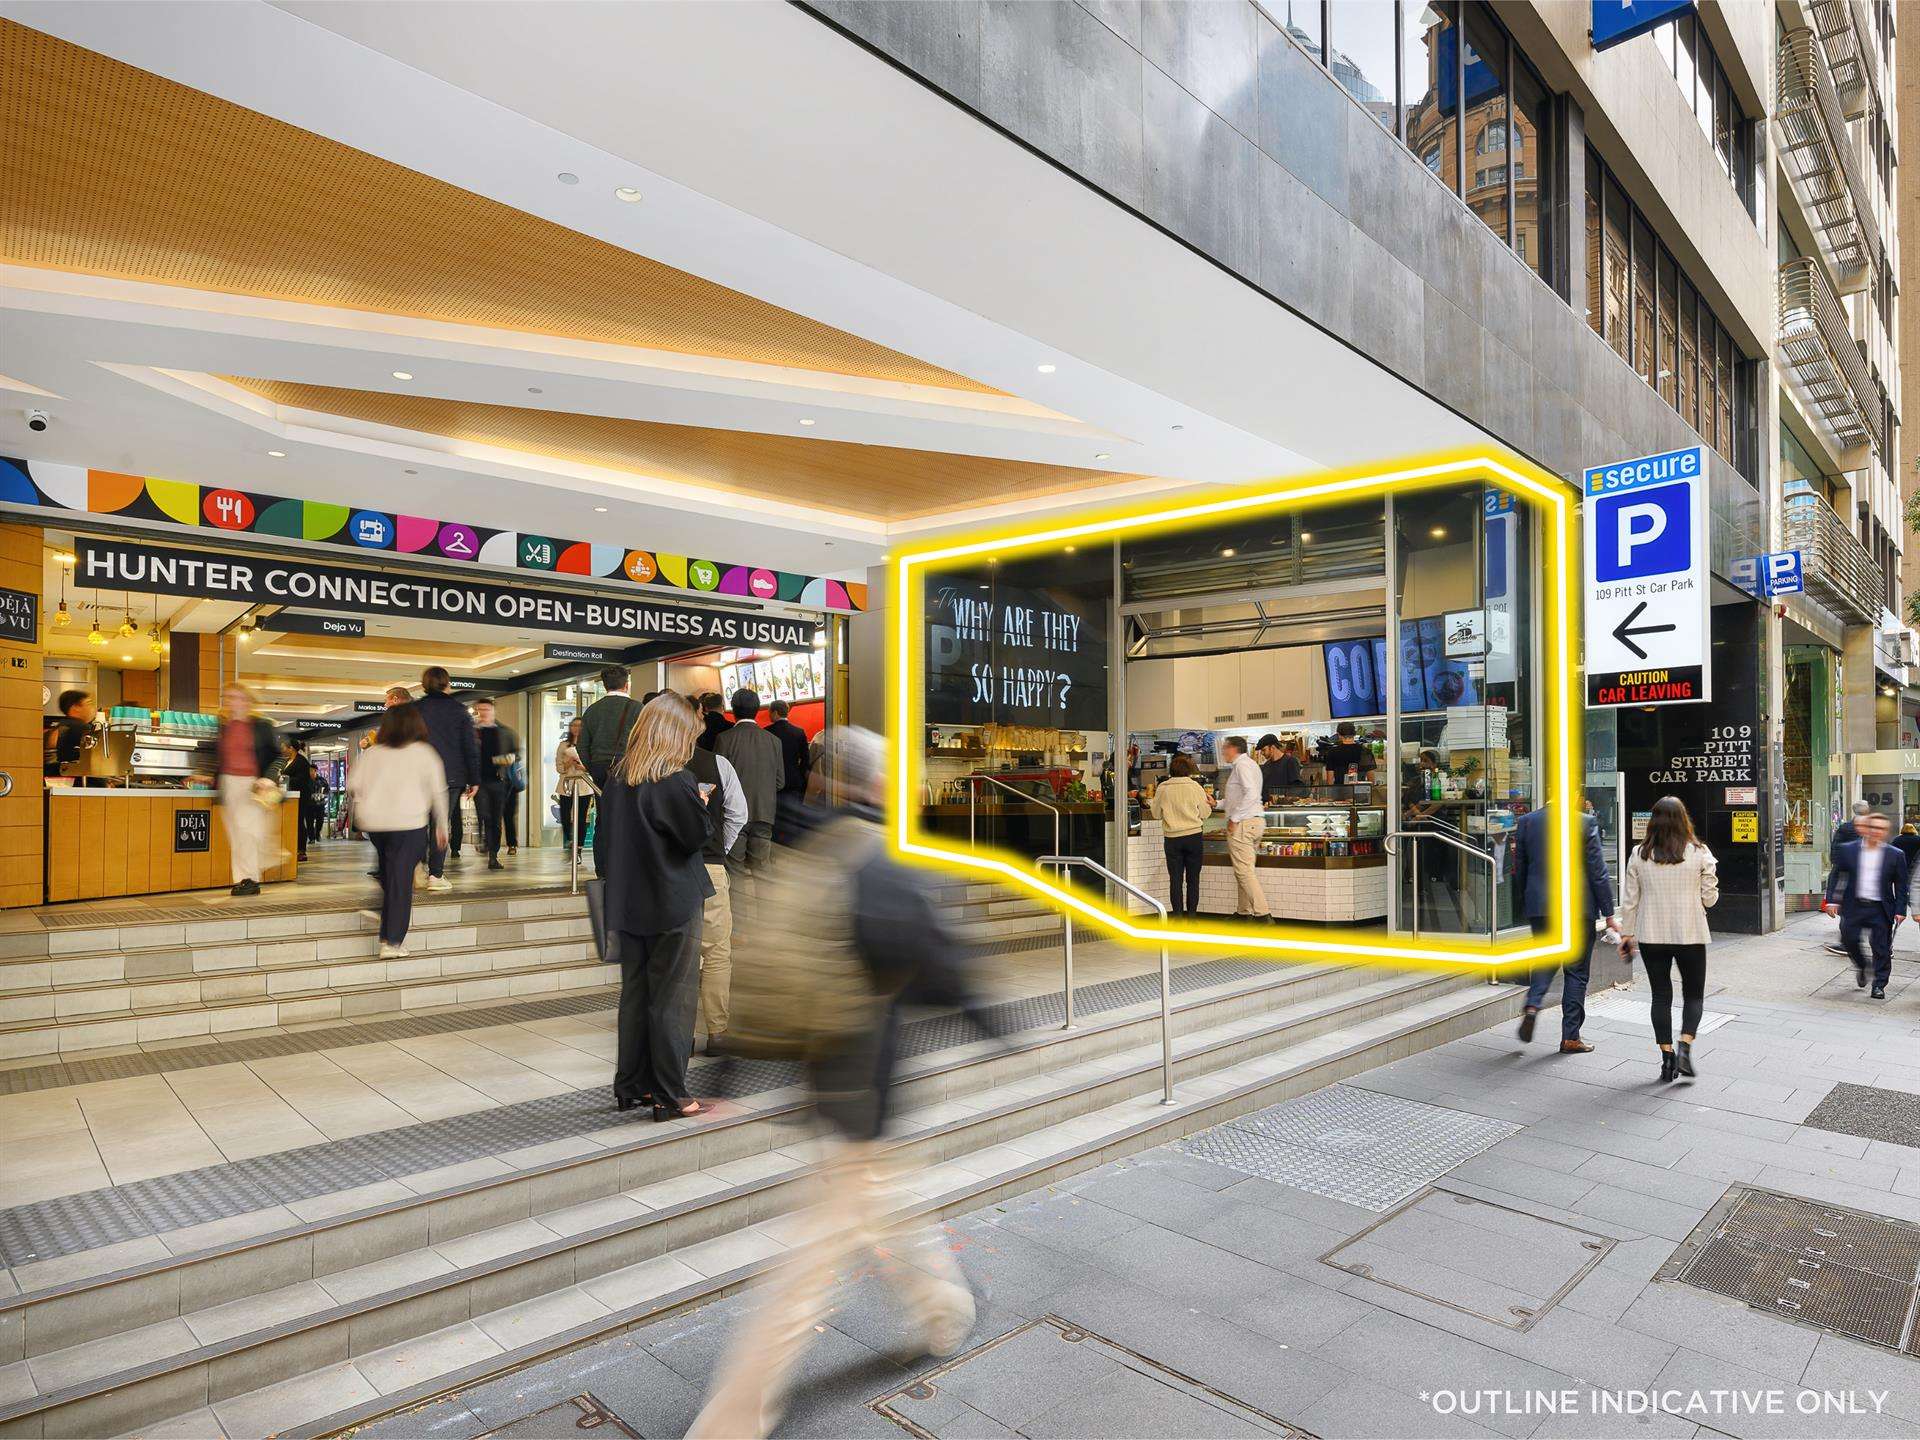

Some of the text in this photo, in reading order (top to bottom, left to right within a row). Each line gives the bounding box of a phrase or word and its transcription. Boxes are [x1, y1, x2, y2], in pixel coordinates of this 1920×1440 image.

[1606, 454, 1696, 488] secure
[1617, 502, 1668, 567] P
[1768, 553, 1796, 578] P
[1596, 578, 1694, 600] 109 Pitt St Car Park
[1770, 575, 1799, 587] PARKING
[87, 549, 810, 646] HUNTER CONNECTION OPEN-BUSINESS AS USUAL
[9, 614, 31, 630] VU
[323, 621, 362, 633] Deja Vu
[953, 598, 1081, 652] WHY ARE THEY
[552, 648, 590, 659] Destination
[1619, 670, 1668, 686] CAUTION
[971, 663, 1072, 710] SO HAPPY?
[1599, 682, 1691, 703] CAR LEAVING
[1711, 725, 1751, 739] 109
[1703, 740, 1751, 754] PITT
[1671, 754, 1751, 769] STREET
[1649, 768, 1752, 784] CAR PARK
[190, 831, 206, 841] VU
